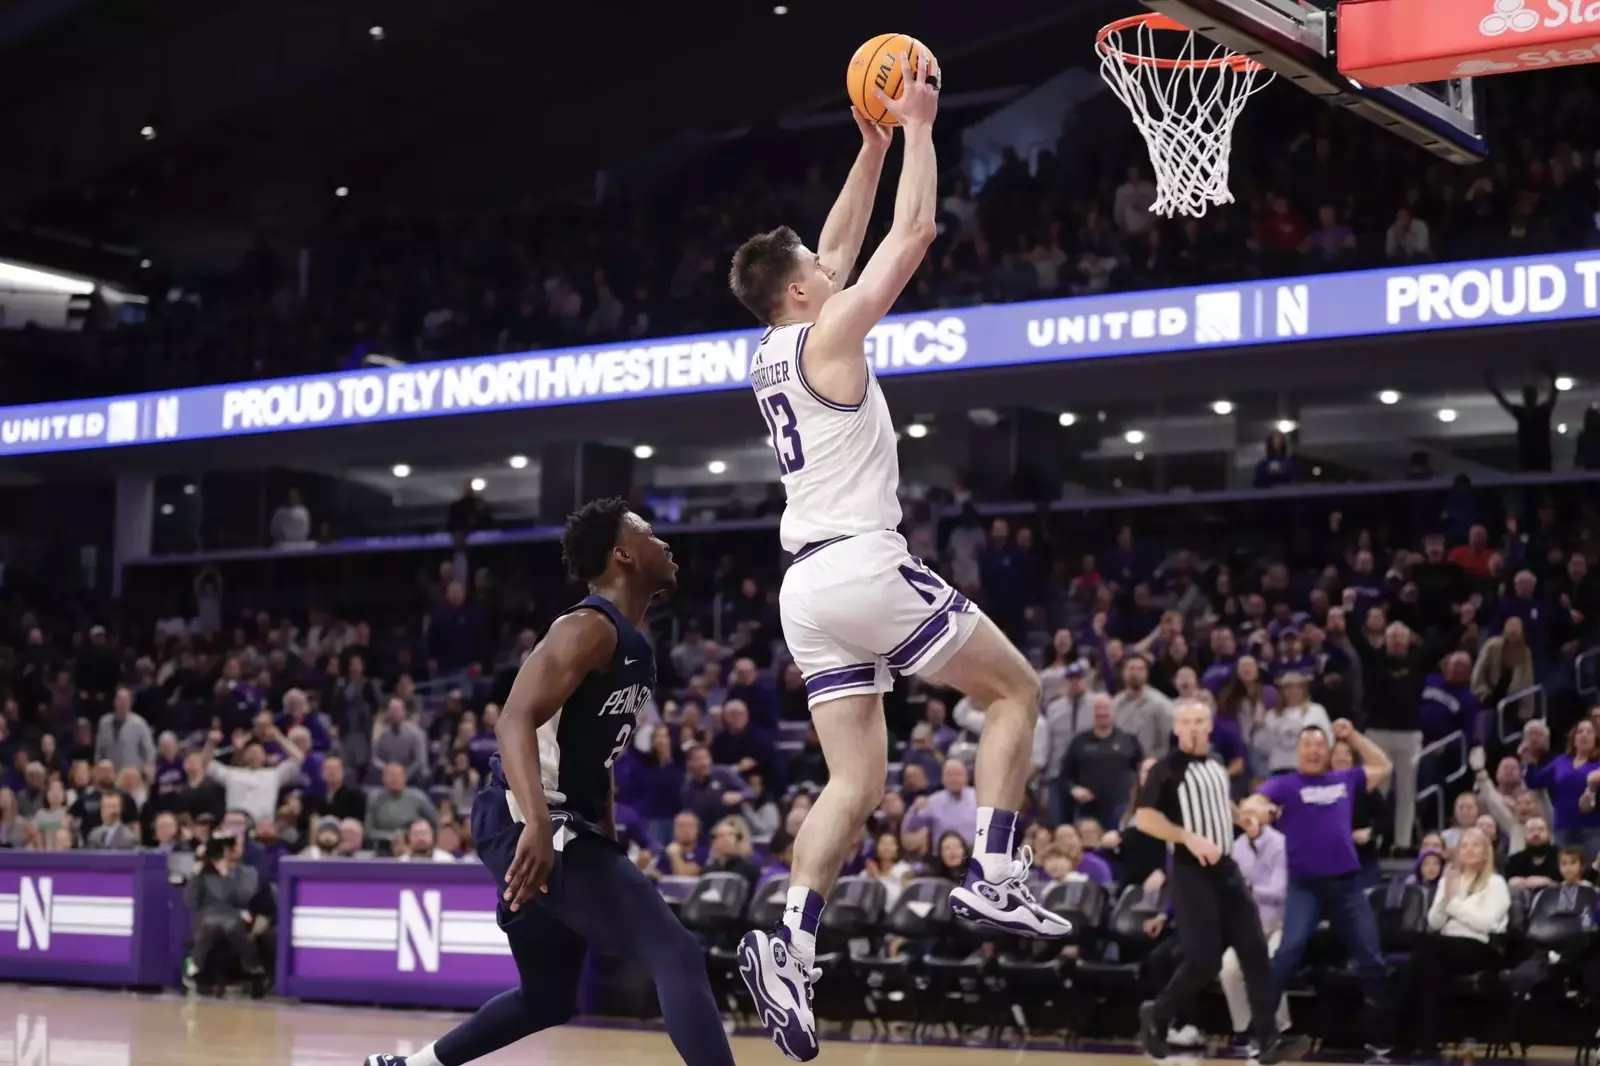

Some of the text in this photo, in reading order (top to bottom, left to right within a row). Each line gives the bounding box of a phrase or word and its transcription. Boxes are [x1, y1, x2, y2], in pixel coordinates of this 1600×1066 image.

[1276, 284, 1309, 337] N
[1386, 264, 1567, 325] PROUD
[1027, 306, 1188, 347] UNITED
[222, 381, 337, 430] PROUD
[337, 375, 384, 418] TO
[386, 369, 440, 413] FLY
[441, 338, 748, 409] NORTHWESTERN
[2, 412, 105, 444] UNITED
[156, 396, 179, 438] N
[17, 876, 53, 950] N
[397, 889, 442, 973] N
